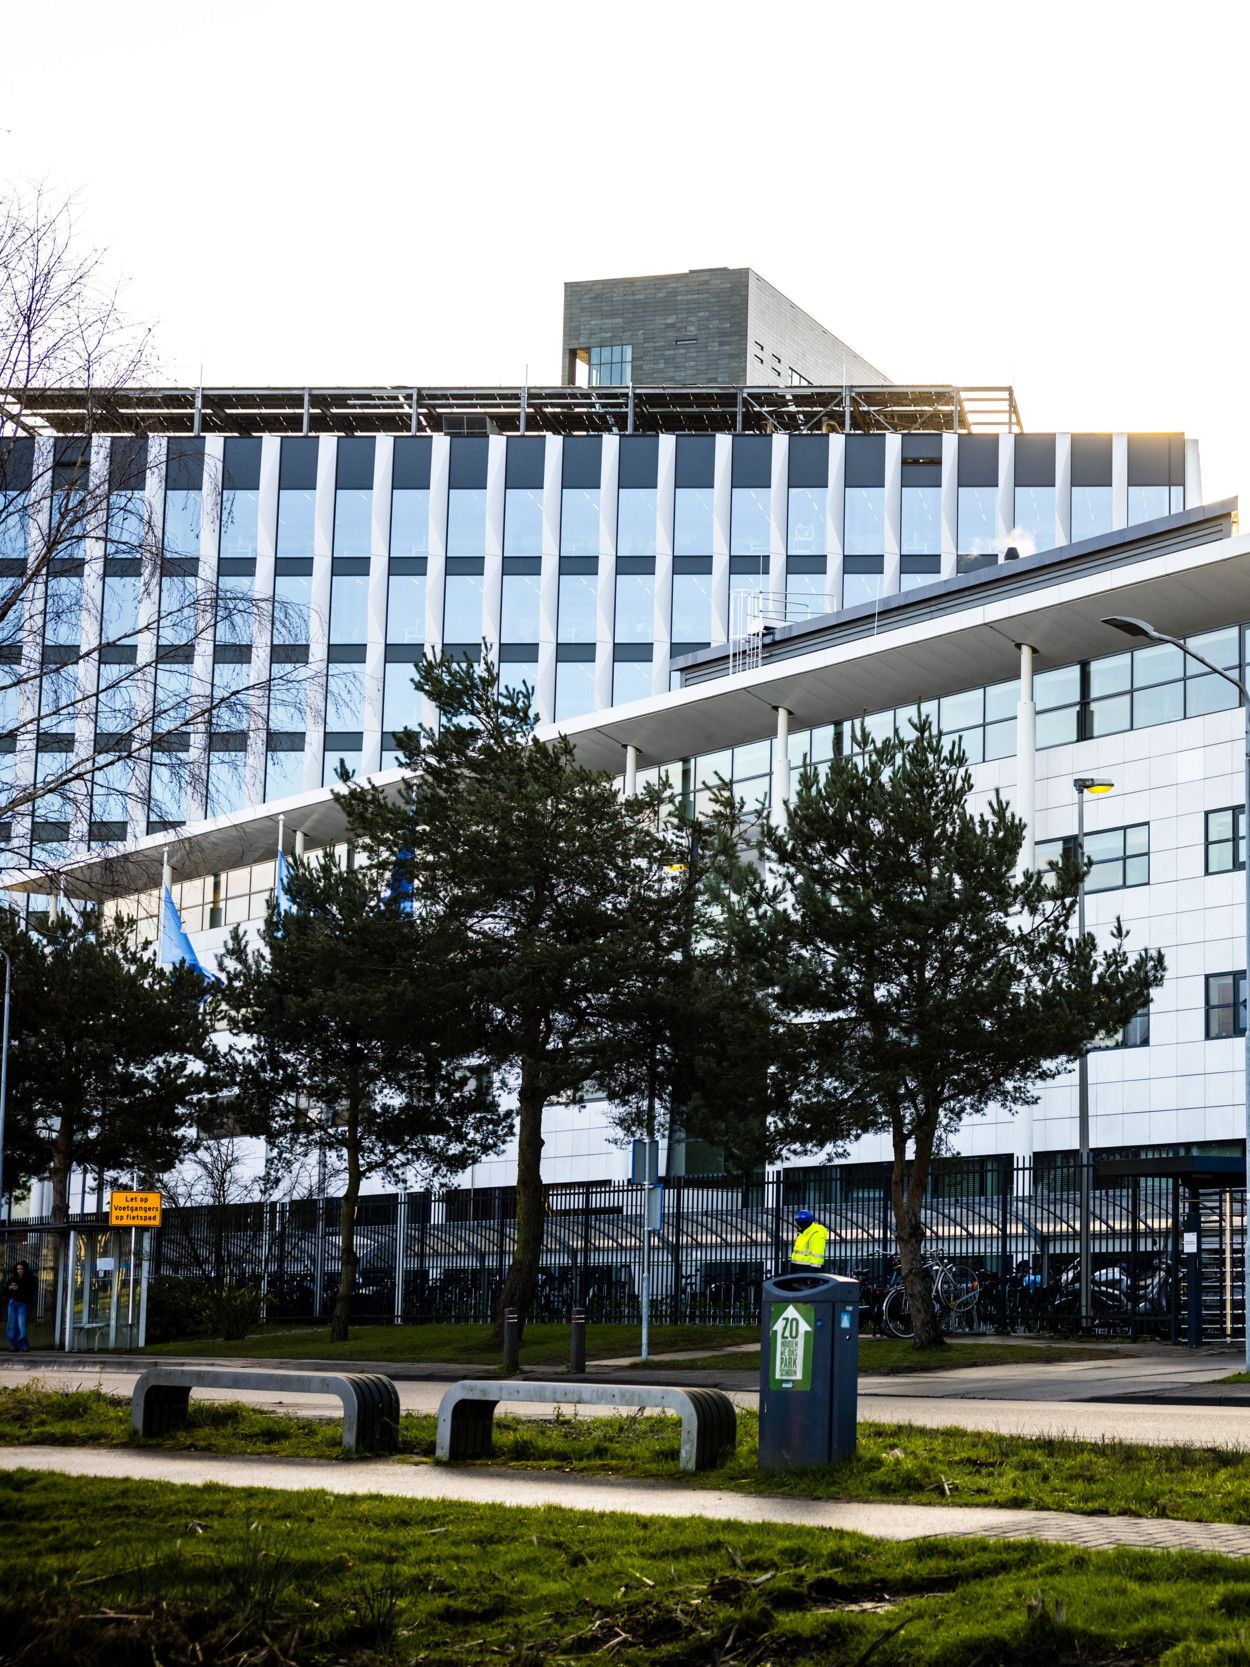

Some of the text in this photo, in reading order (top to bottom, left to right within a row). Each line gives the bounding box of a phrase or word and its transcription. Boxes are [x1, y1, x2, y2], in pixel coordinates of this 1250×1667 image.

[113, 1205, 159, 1213] Voetgangers
[782, 1318, 799, 1340] ZO
[780, 1357, 798, 1368] PARK
